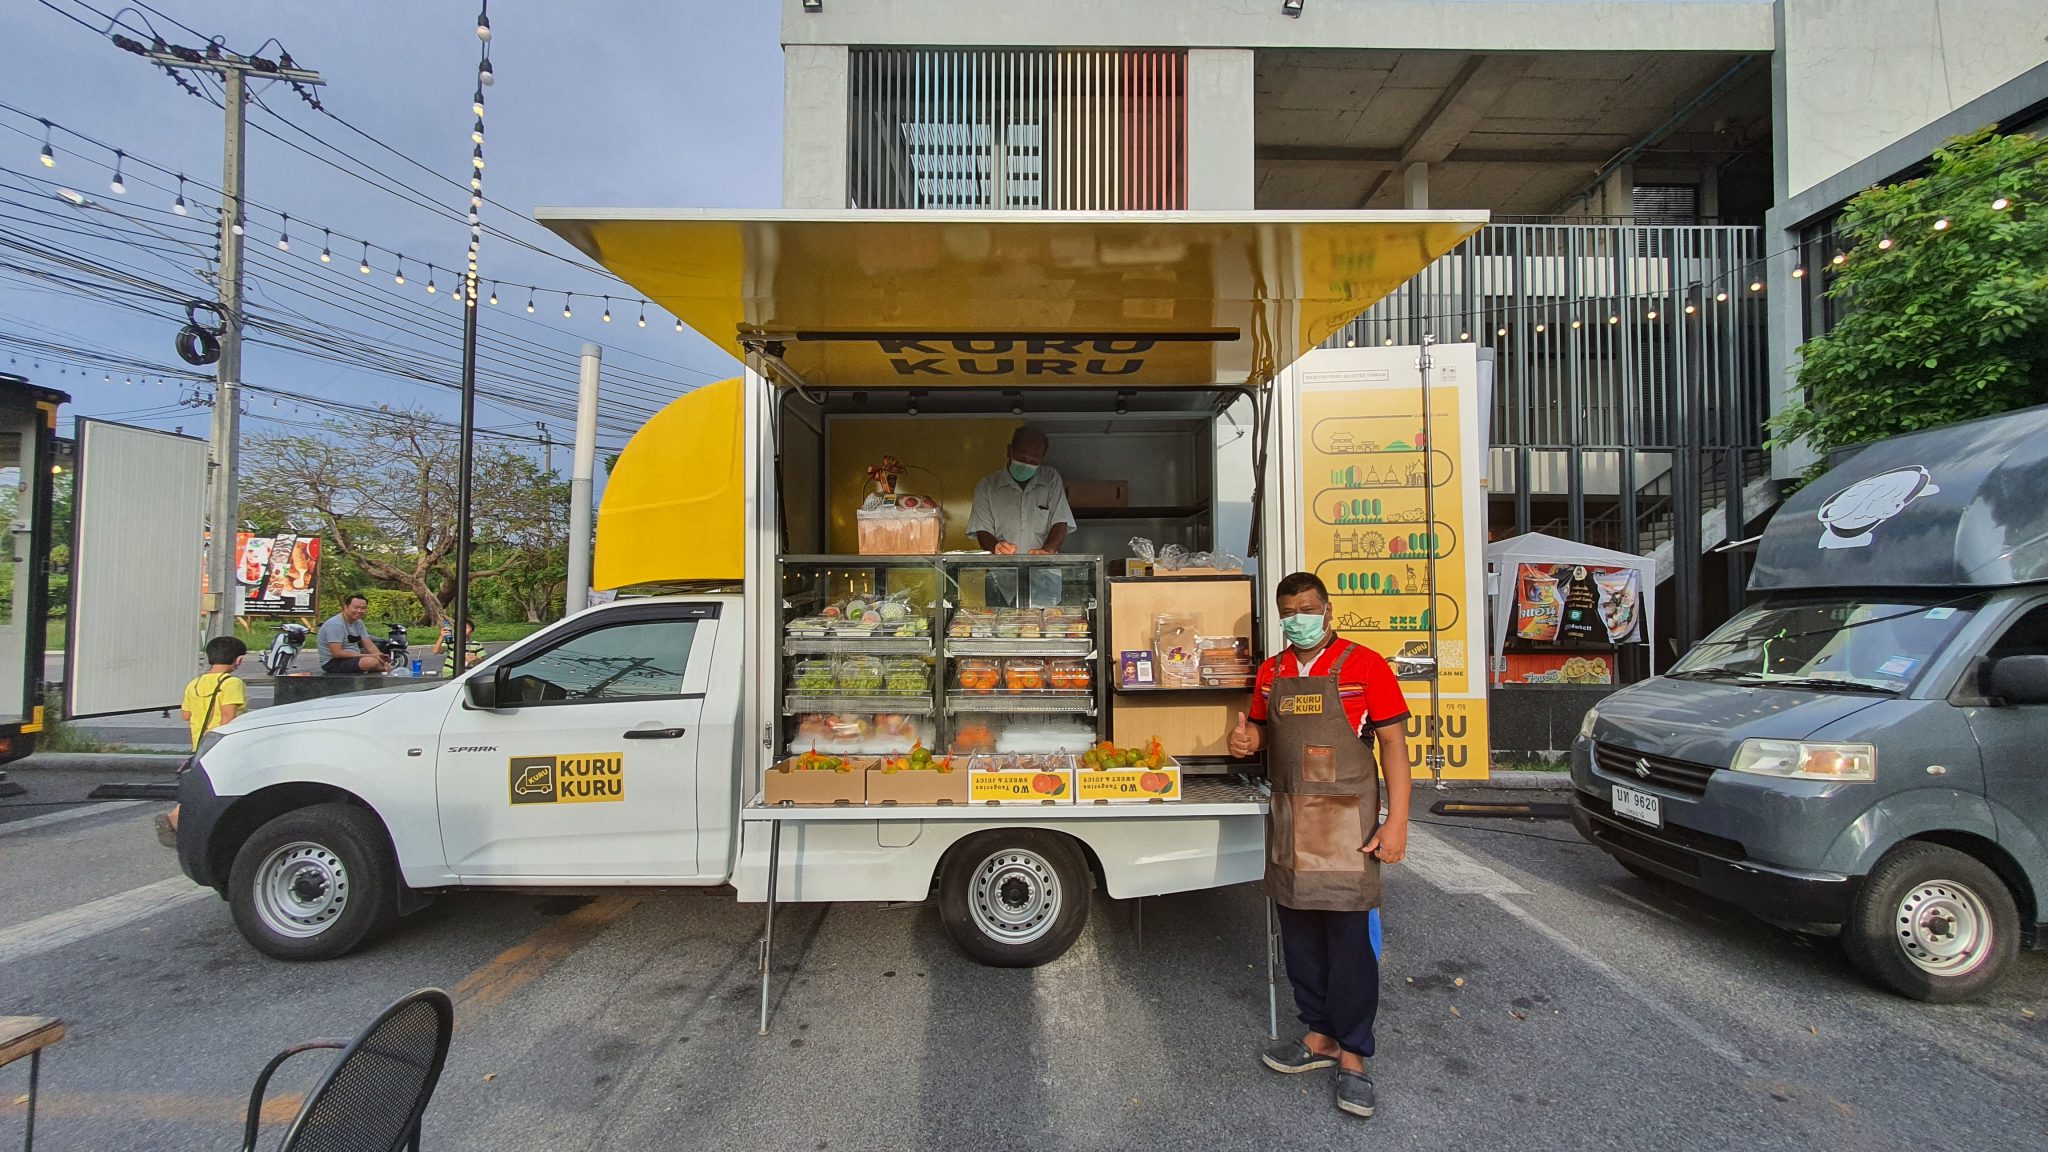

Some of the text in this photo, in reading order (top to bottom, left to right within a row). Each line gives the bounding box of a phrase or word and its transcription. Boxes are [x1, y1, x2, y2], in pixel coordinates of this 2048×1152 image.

[889, 358, 1145, 375] KURU
[1406, 642, 1428, 657] KURU
[1296, 695, 1321, 704] KURU
[1296, 704, 1321, 712] KURU
[1404, 715, 1467, 738] URU
[1407, 744, 1468, 768] UU
[560, 758, 622, 777] KURU
[527, 768, 549, 785] KURU
[560, 779, 622, 798] KURU
[1013, 785, 1029, 794] WO
[1120, 783, 1137, 792] WO
[1634, 794, 1657, 812] 9620
